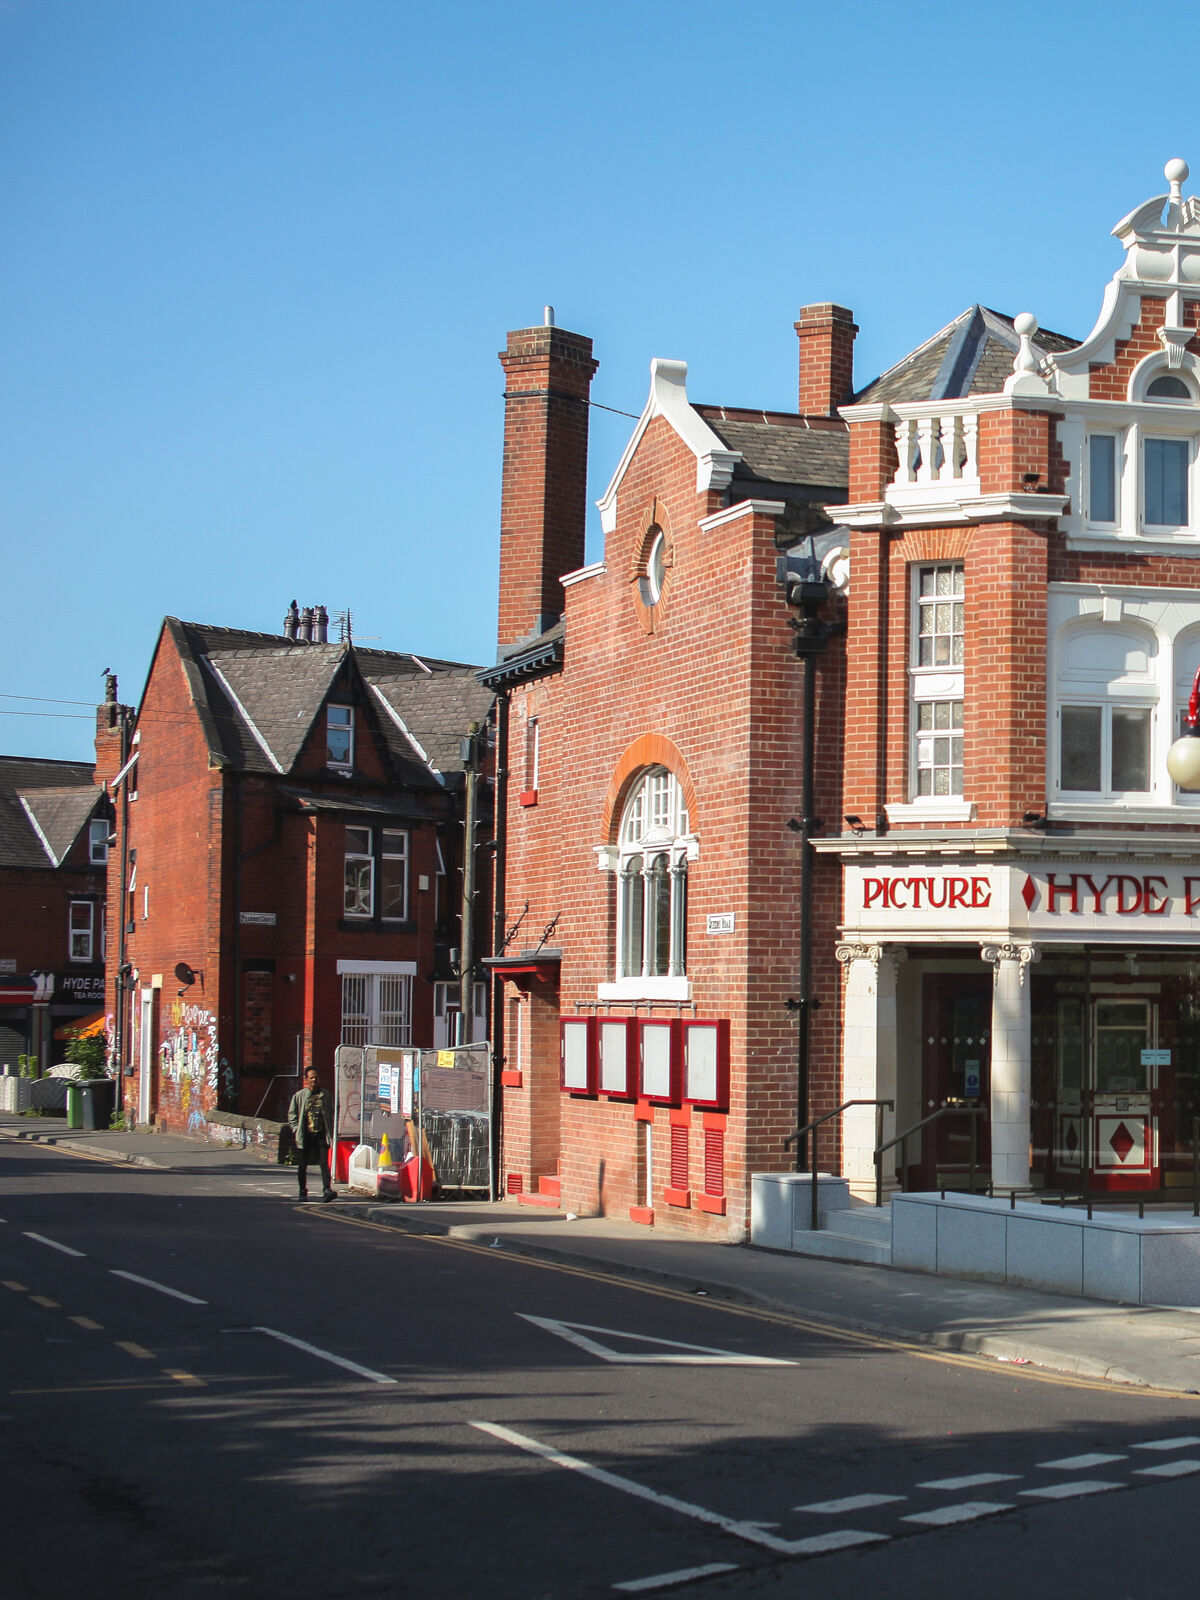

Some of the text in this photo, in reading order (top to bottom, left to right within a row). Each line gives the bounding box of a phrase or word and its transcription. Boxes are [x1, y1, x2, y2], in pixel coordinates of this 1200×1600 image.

[862, 877, 992, 909] PICTURE
[1046, 873, 1170, 914] HYDE
[62, 977, 91, 990] HYDE
